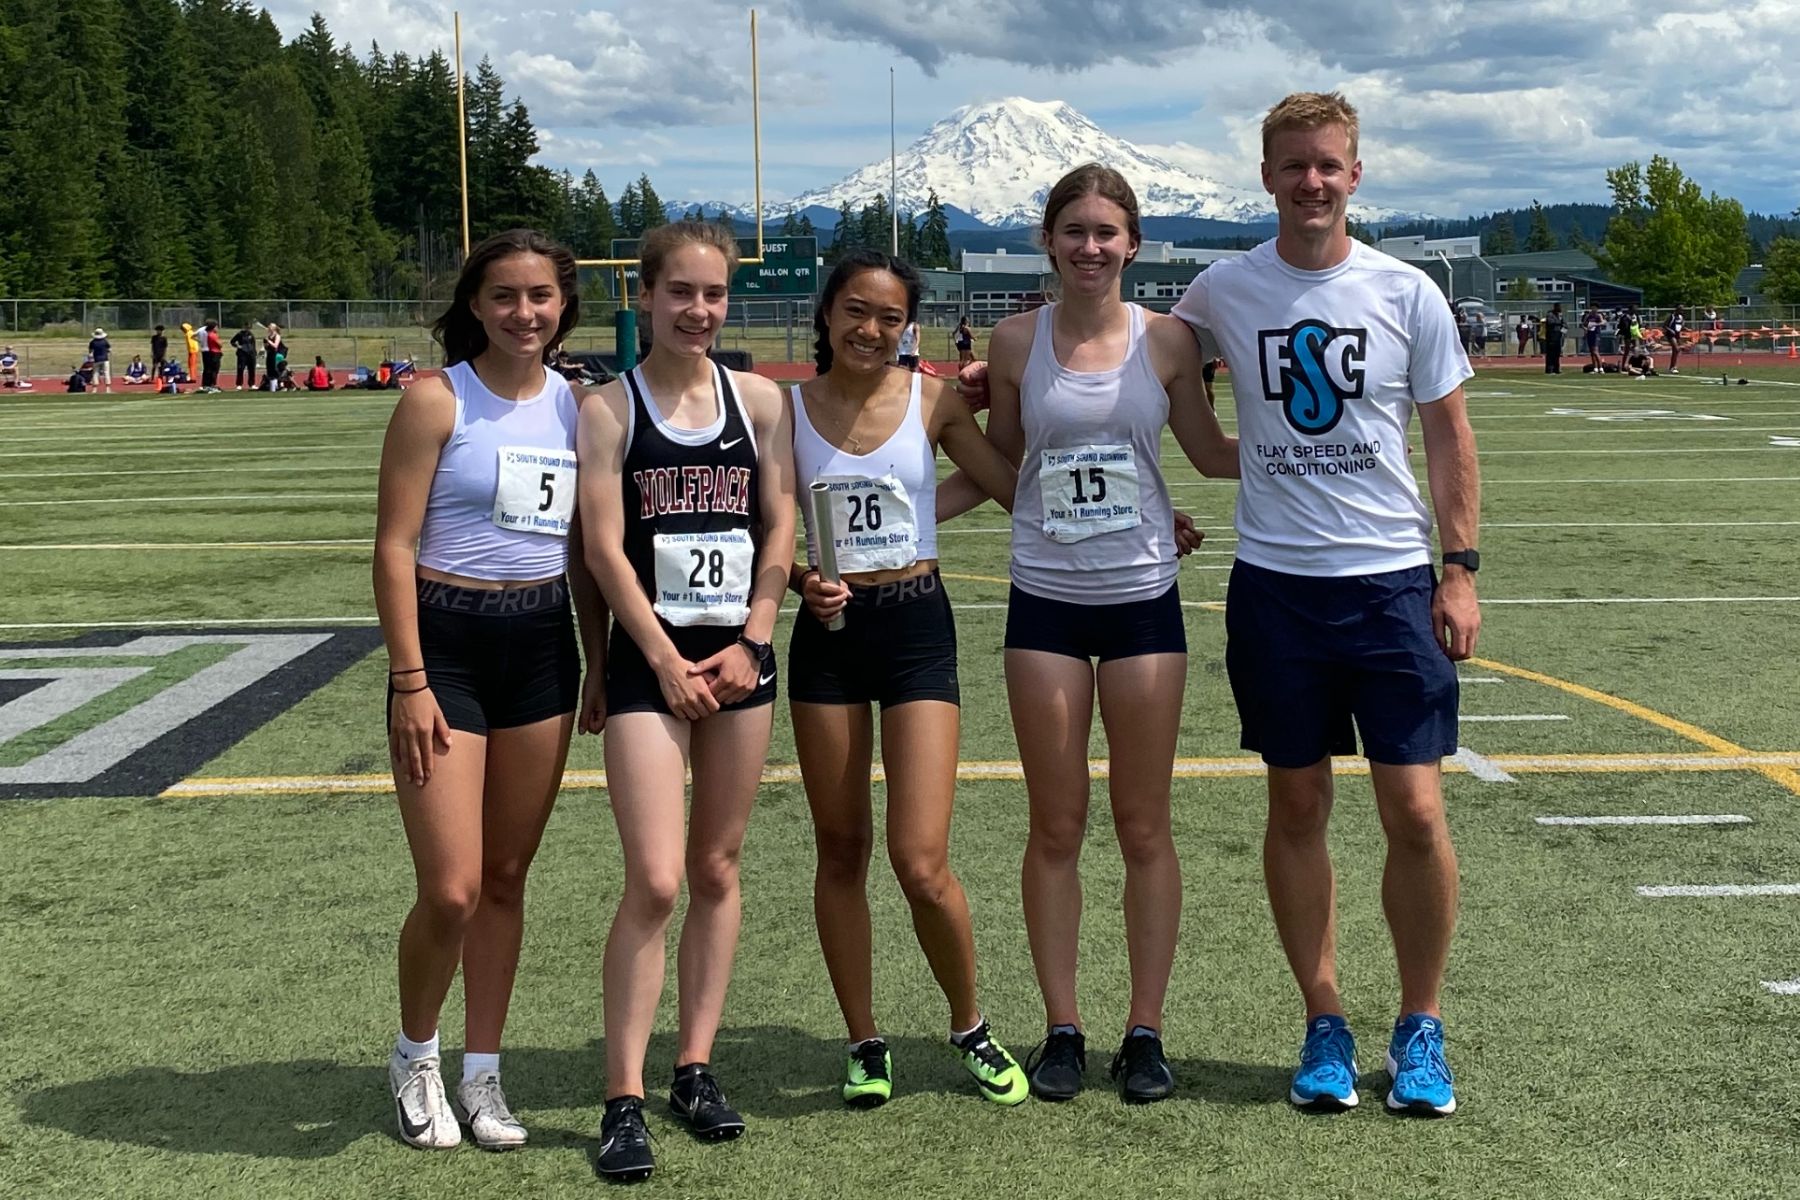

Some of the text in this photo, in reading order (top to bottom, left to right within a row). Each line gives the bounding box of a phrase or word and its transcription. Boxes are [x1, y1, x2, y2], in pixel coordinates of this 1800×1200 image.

[761, 243, 788, 253] GUEST
[616, 270, 639, 279] DWN
[759, 268, 789, 277] BALL ON
[794, 267, 810, 277] QTR
[1257, 440, 1381, 458] FLAY SPEED AND
[516, 453, 537, 464] SOUTH
[539, 456, 560, 467] SOUND
[1266, 458, 1376, 476] CONDITIONING
[538, 472, 555, 511] 5
[634, 466, 751, 520] WOLFPACK
[829, 482, 849, 492] SOUTH
[1069, 467, 1106, 504] 15
[847, 494, 882, 532] 26
[1050, 508, 1065, 519] Your
[1080, 506, 1111, 518] Running
[1113, 504, 1133, 515] Store
[501, 511, 518, 524] Your
[521, 516, 531, 526] #1
[534, 515, 559, 531] Running
[672, 533, 747, 543] SOUTH SOUND RUNNING
[844, 537, 853, 546] #1
[856, 535, 887, 546] Running
[889, 532, 909, 543] Store
[689, 549, 724, 588] 28
[662, 590, 743, 604] Your #1 Running Store
[876, 575, 937, 606] PRO
[480, 586, 542, 612] PRO
